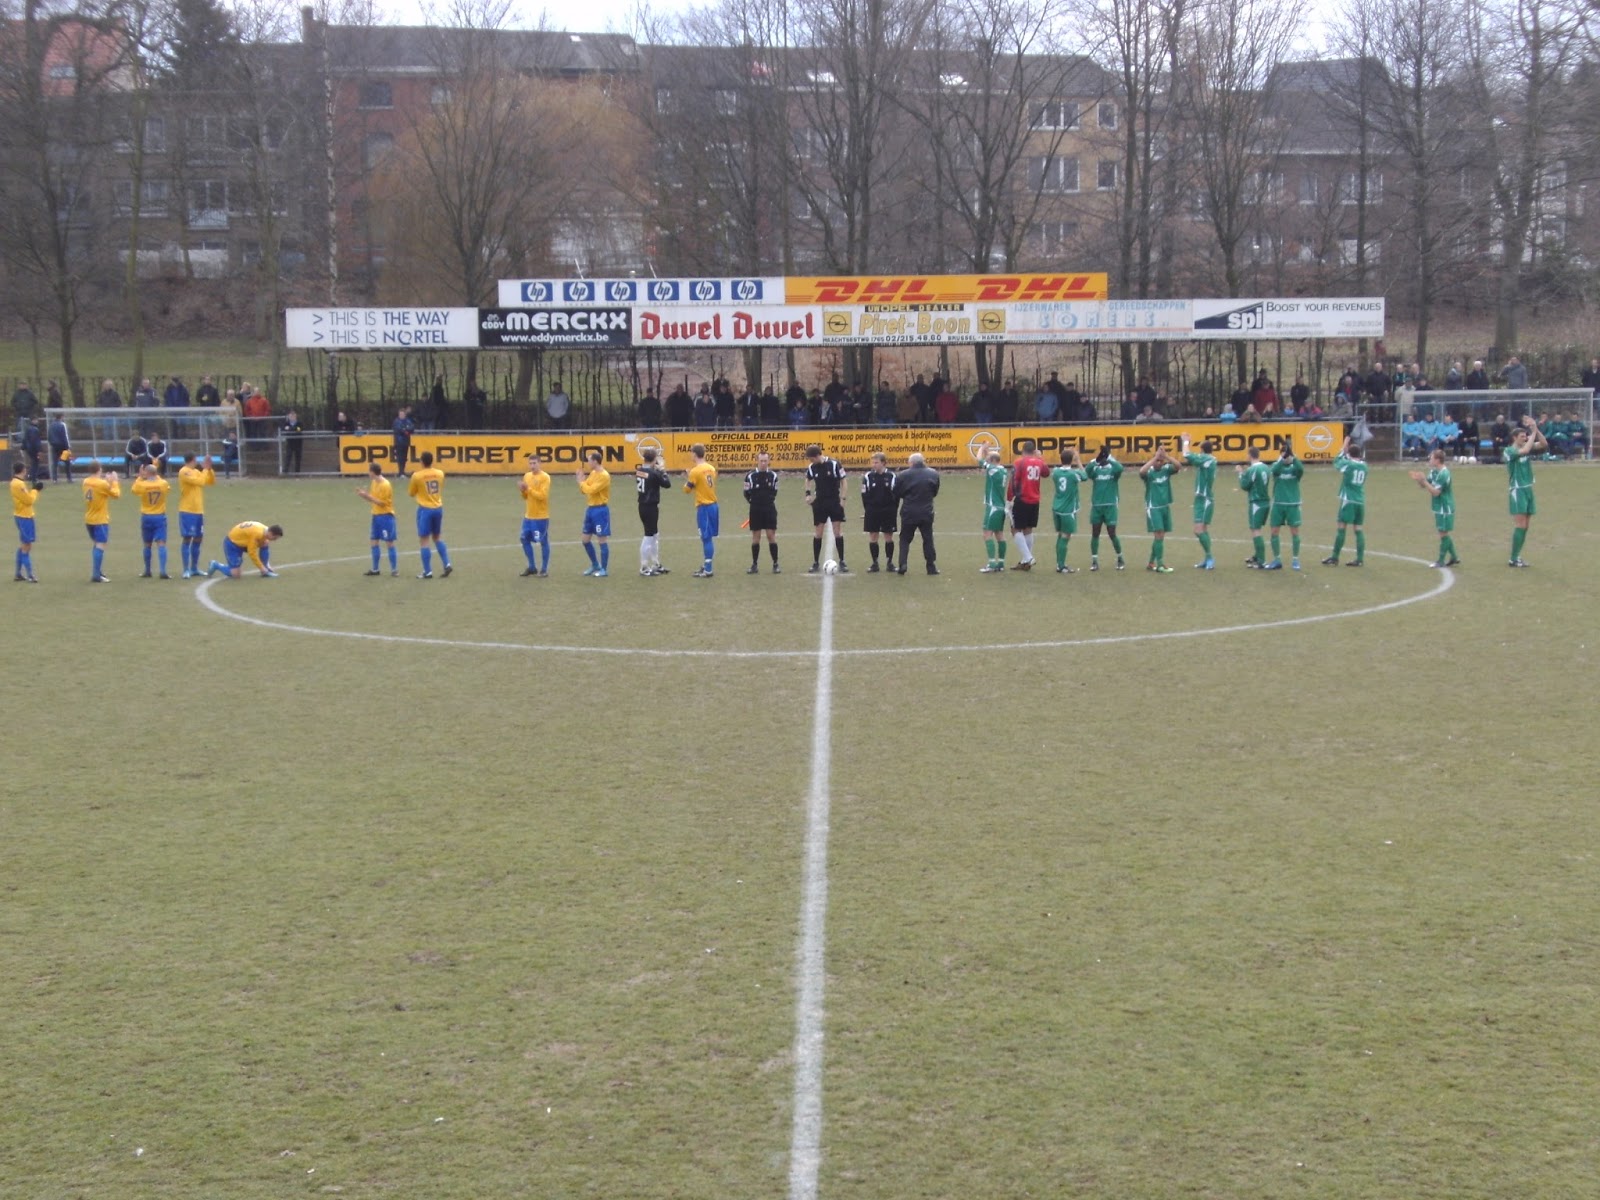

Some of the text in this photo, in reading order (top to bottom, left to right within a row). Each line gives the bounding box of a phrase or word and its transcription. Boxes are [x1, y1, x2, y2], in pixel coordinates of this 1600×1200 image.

[815, 279, 935, 302] DHL
[976, 276, 1098, 300] DHL
[880, 304, 915, 312] OPEL
[919, 303, 961, 312] DEALER
[1332, 302, 1382, 311] REVENUES
[329, 311, 358, 325] THIS
[365, 311, 376, 325] IS
[383, 311, 410, 325] THE
[415, 311, 449, 325] WAY
[482, 311, 627, 330] EDDY MERCKX
[859, 313, 971, 336] Piret-Boon
[1227, 307, 1263, 331] spi
[639, 311, 815, 340] Duvel Duvel
[330, 330, 359, 344] THIS
[366, 330, 377, 344] IS
[383, 330, 448, 345] NORTEL
[500, 333, 609, 344] www.eddymerckx.be
[677, 444, 751, 452] HAASESTEENWEG
[754, 444, 768, 452] 1765
[776, 443, 792, 452] 1030
[794, 442, 825, 451] BRUL
[831, 445, 839, 453] OK
[842, 445, 865, 453] QUALITY
[1012, 436, 1096, 455] OPEL
[777, 452, 808, 460] 243.78.9
[1304, 451, 1334, 459] OPEL
[1027, 466, 1040, 480] 30
[1352, 469, 1365, 484] 10
[425, 480, 439, 494] 19
[636, 477, 645, 492] 21
[1059, 477, 1067, 492] 3
[85, 488, 93, 501] 4
[147, 491, 161, 505] 17
[595, 524, 602, 533] 6
